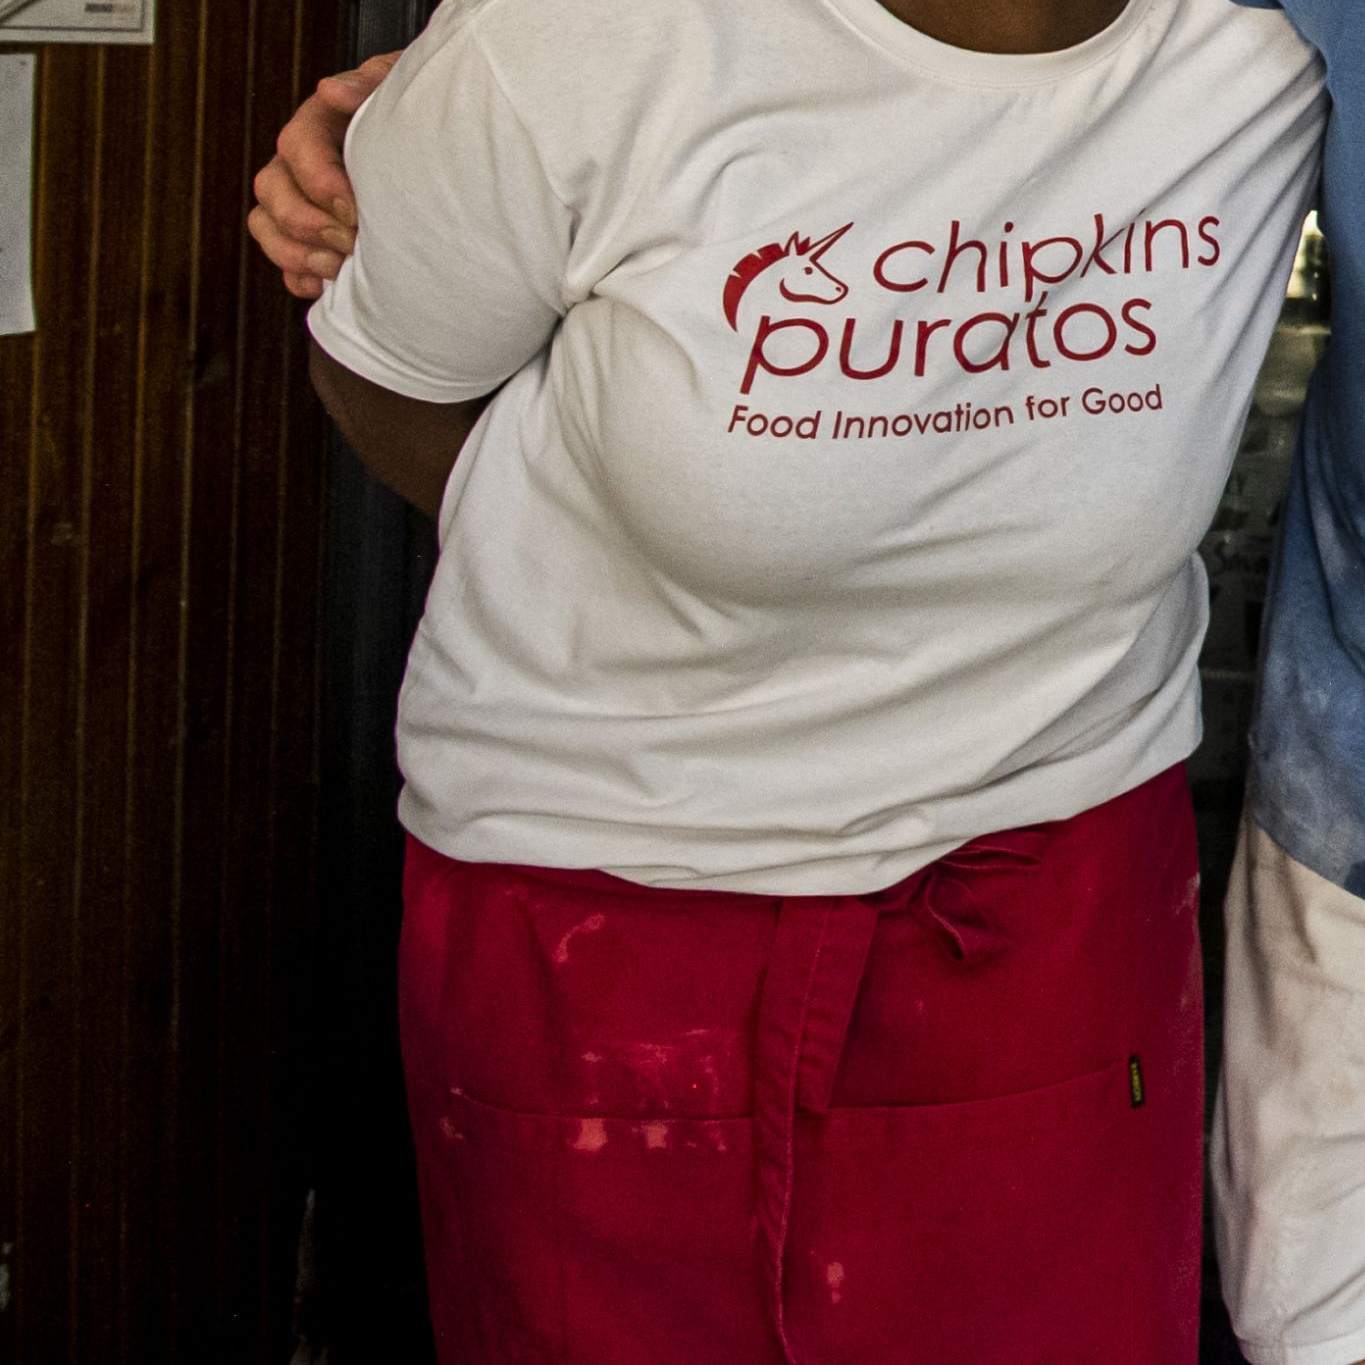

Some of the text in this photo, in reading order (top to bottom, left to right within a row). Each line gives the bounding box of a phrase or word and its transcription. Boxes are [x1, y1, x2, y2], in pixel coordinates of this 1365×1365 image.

[873, 209, 1221, 303] chipkins
[739, 291, 1158, 395] puratos
[727, 383, 1164, 440] Food Innovation for Good
